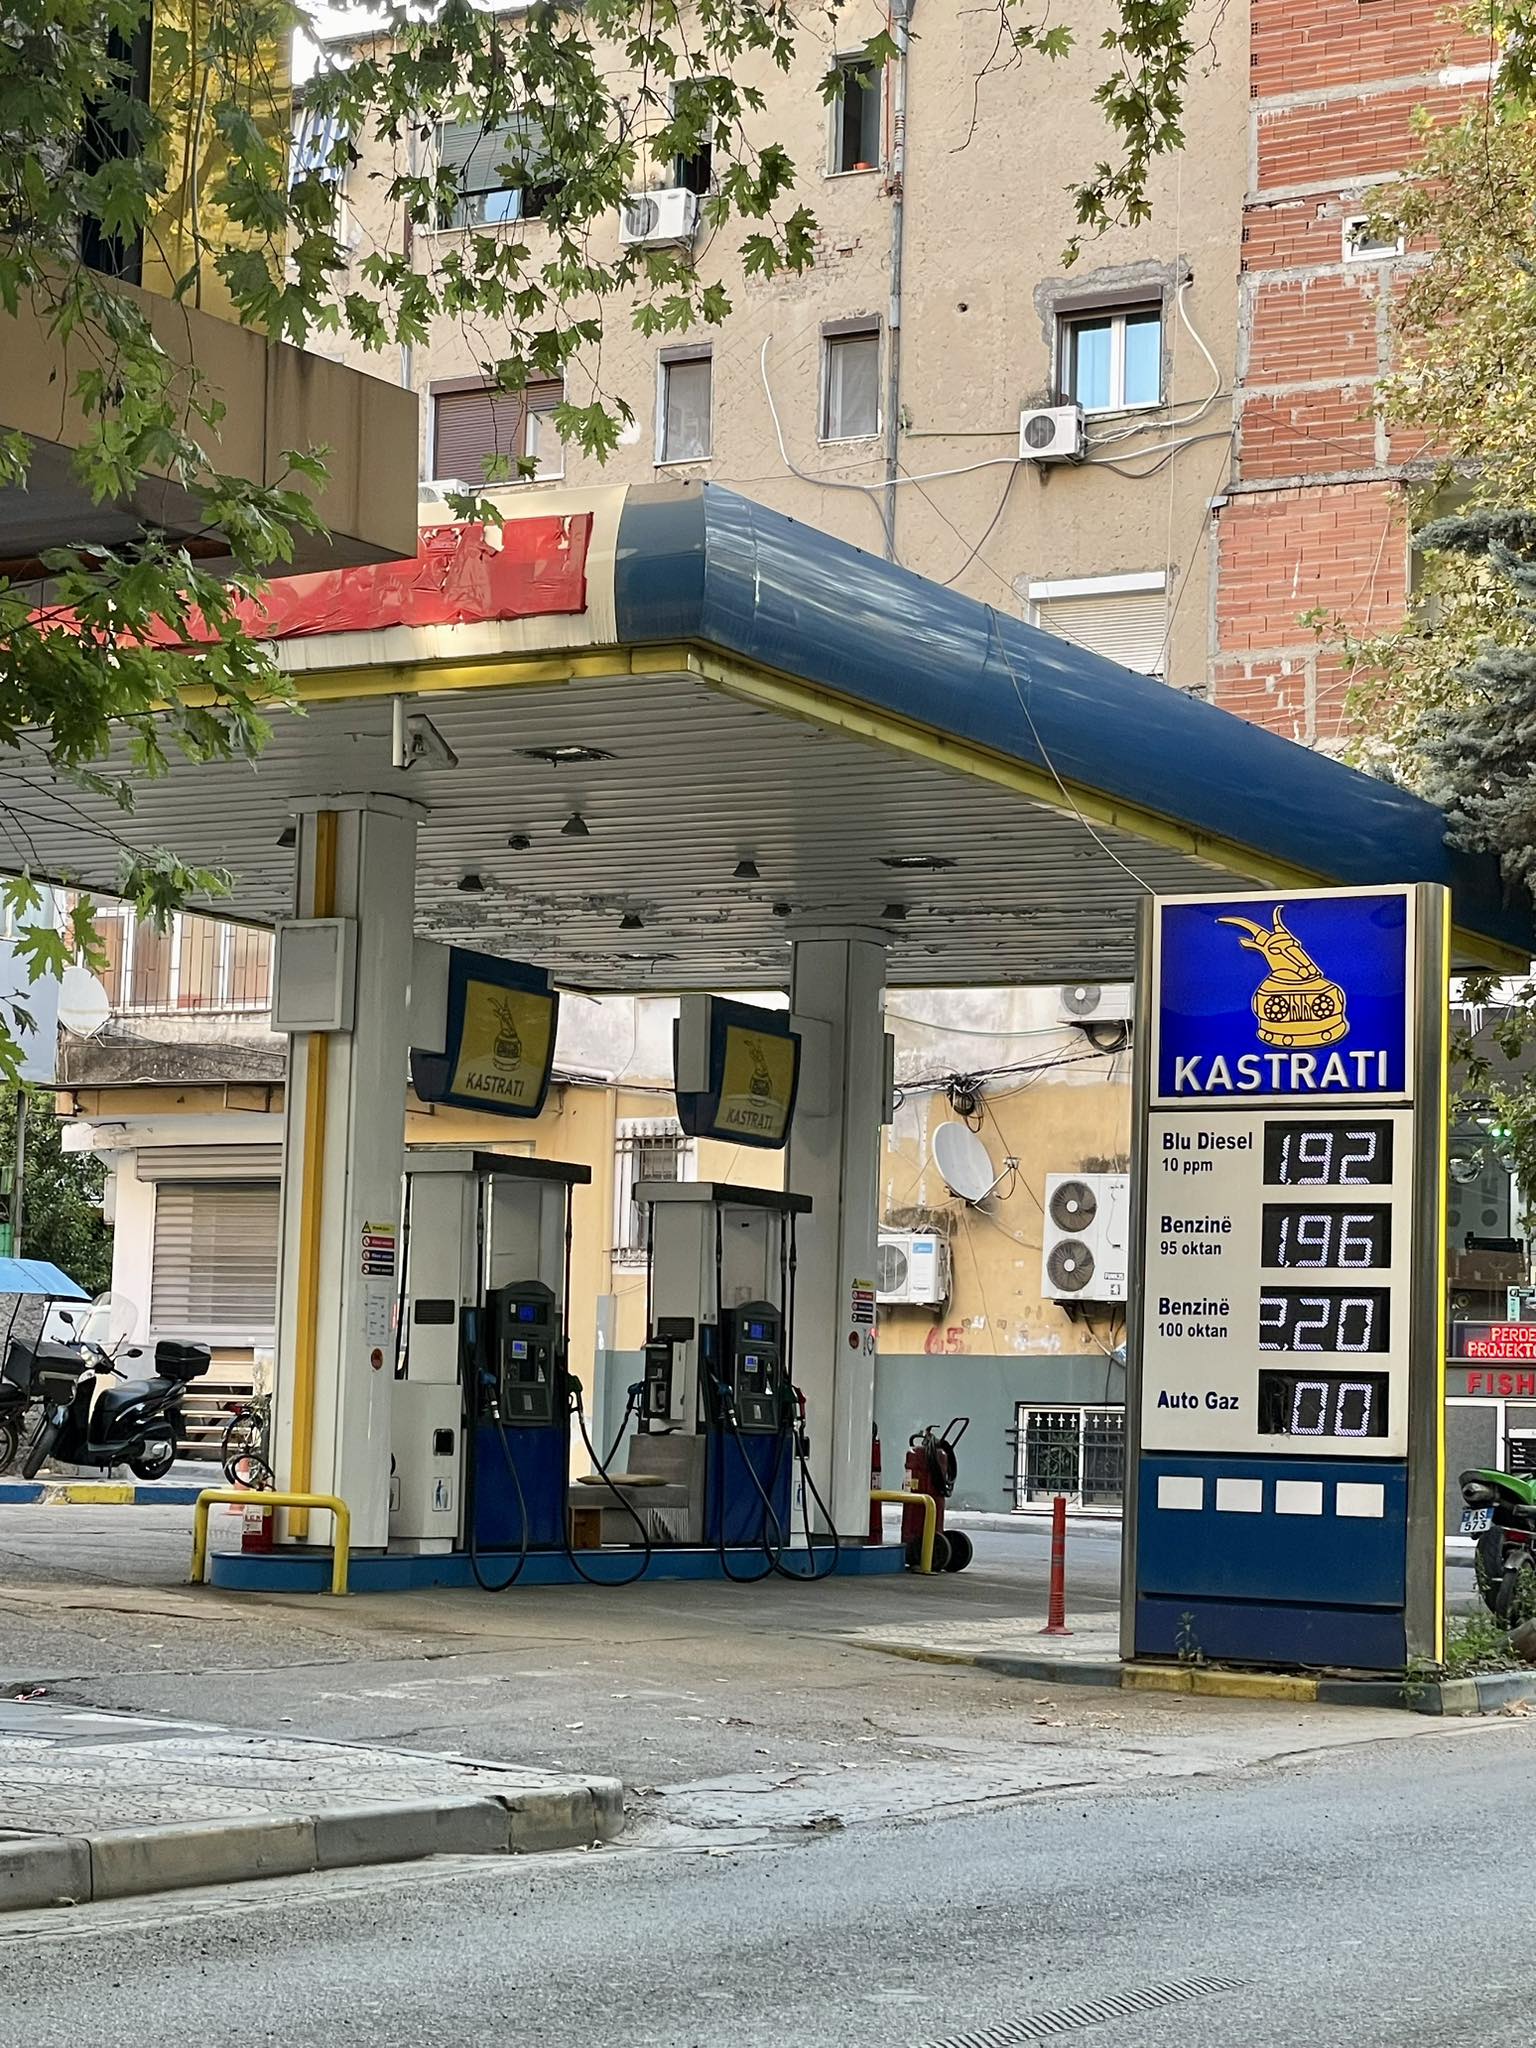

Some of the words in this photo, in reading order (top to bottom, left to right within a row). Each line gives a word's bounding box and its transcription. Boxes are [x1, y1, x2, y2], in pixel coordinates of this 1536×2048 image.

[1174, 1050, 1388, 1092] KASTRATI
[465, 1072, 524, 1097] KASTRATI
[727, 1108, 774, 1130] KASTRATI
[1162, 1132, 1191, 1150] Blu
[1198, 1132, 1253, 1150] Diesel
[1162, 1157, 1179, 1171] 10
[1183, 1160, 1213, 1175] ppm
[1160, 1215, 1232, 1233] Benzinë
[1160, 1241, 1177, 1255] 95
[1182, 1241, 1222, 1255] oktan
[1158, 1297, 1230, 1315] Benzinë
[1158, 1322, 1183, 1337] 100
[1188, 1323, 1228, 1338] oktan
[1467, 1371, 1536, 1395] FISH
[1157, 1390, 1199, 1408] Auto
[1205, 1391, 1240, 1409] Gaz
